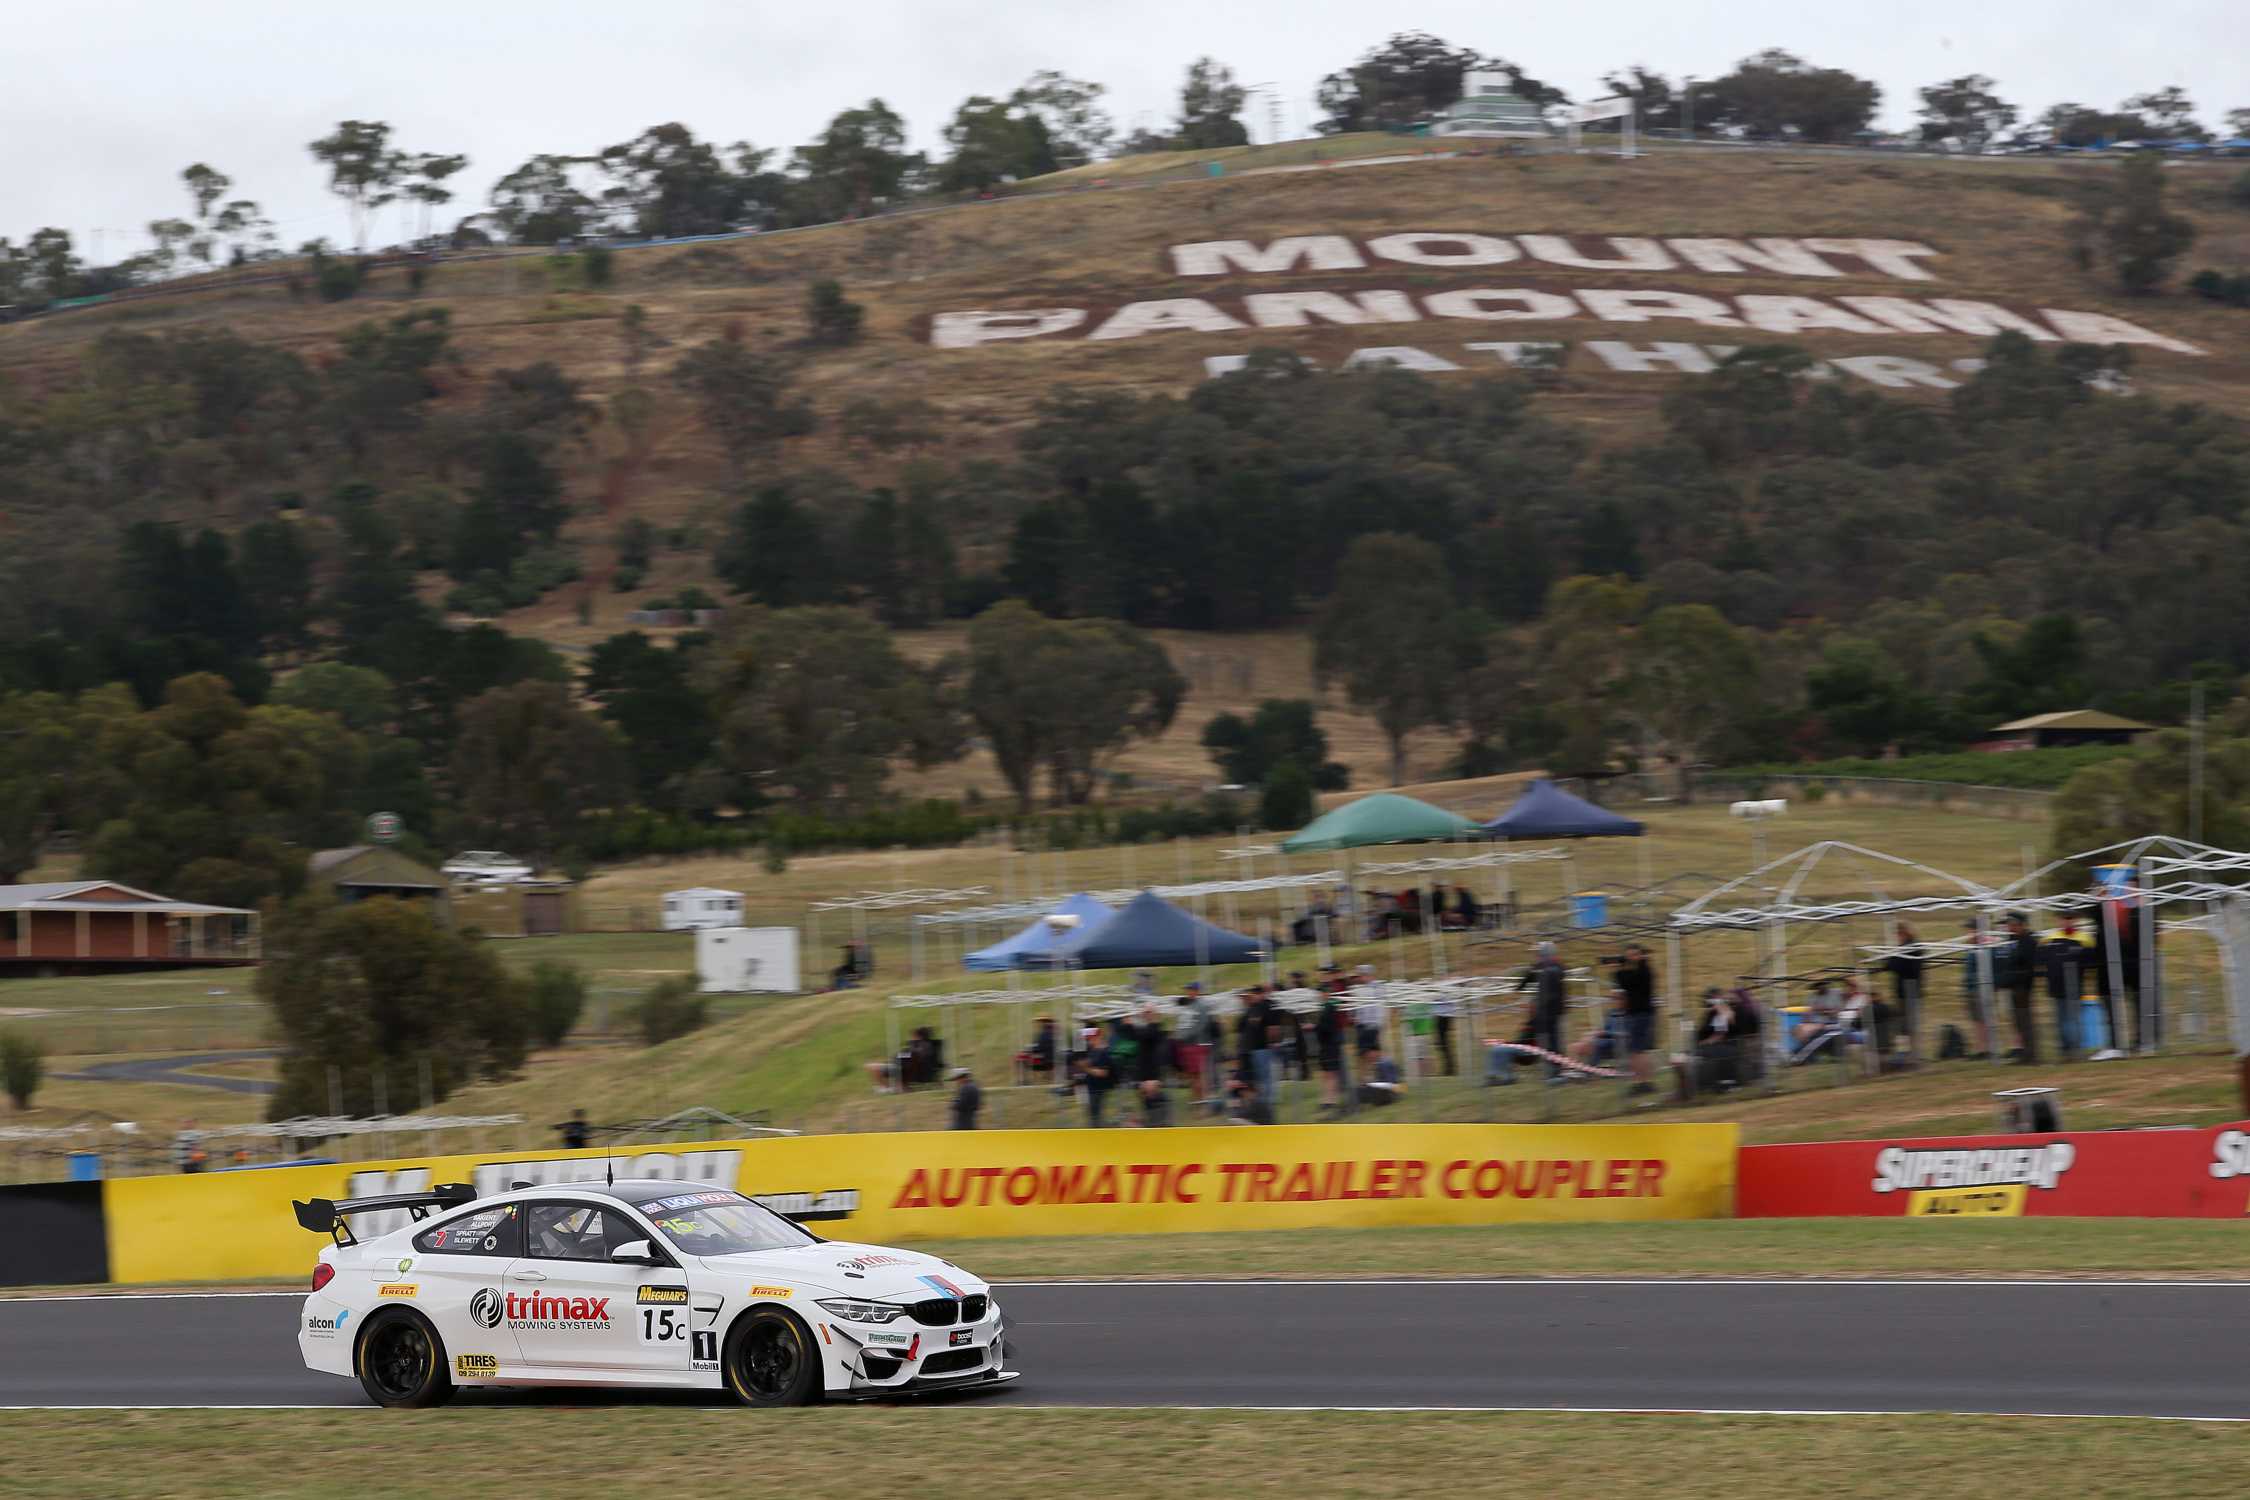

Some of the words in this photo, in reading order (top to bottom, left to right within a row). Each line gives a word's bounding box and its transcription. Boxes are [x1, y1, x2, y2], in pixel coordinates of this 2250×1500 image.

[1171, 232, 1939, 281] MOUNT
[930, 288, 2211, 356] PANORAMA
[1871, 1142, 2076, 1193] SUPERCHEAP
[889, 1163, 1204, 1209] AUTOMATIC
[1216, 1159, 1429, 1203] TRAILER
[1441, 1158, 1668, 1200] COUPLER
[1920, 1191, 2010, 1215] AUTO
[380, 1286, 416, 1295] PIRELLI
[639, 1286, 687, 1301] MEGUIAR'S
[751, 1287, 790, 1297] PIRELLI
[505, 1289, 610, 1321] trimax
[308, 1315, 334, 1329] alcon
[507, 1321, 556, 1330] MOWING
[559, 1321, 611, 1330] SYSTEMS
[699, 1333, 709, 1359] 1
[463, 1355, 496, 1367] TIRES
[692, 1362, 713, 1370] Mobil
